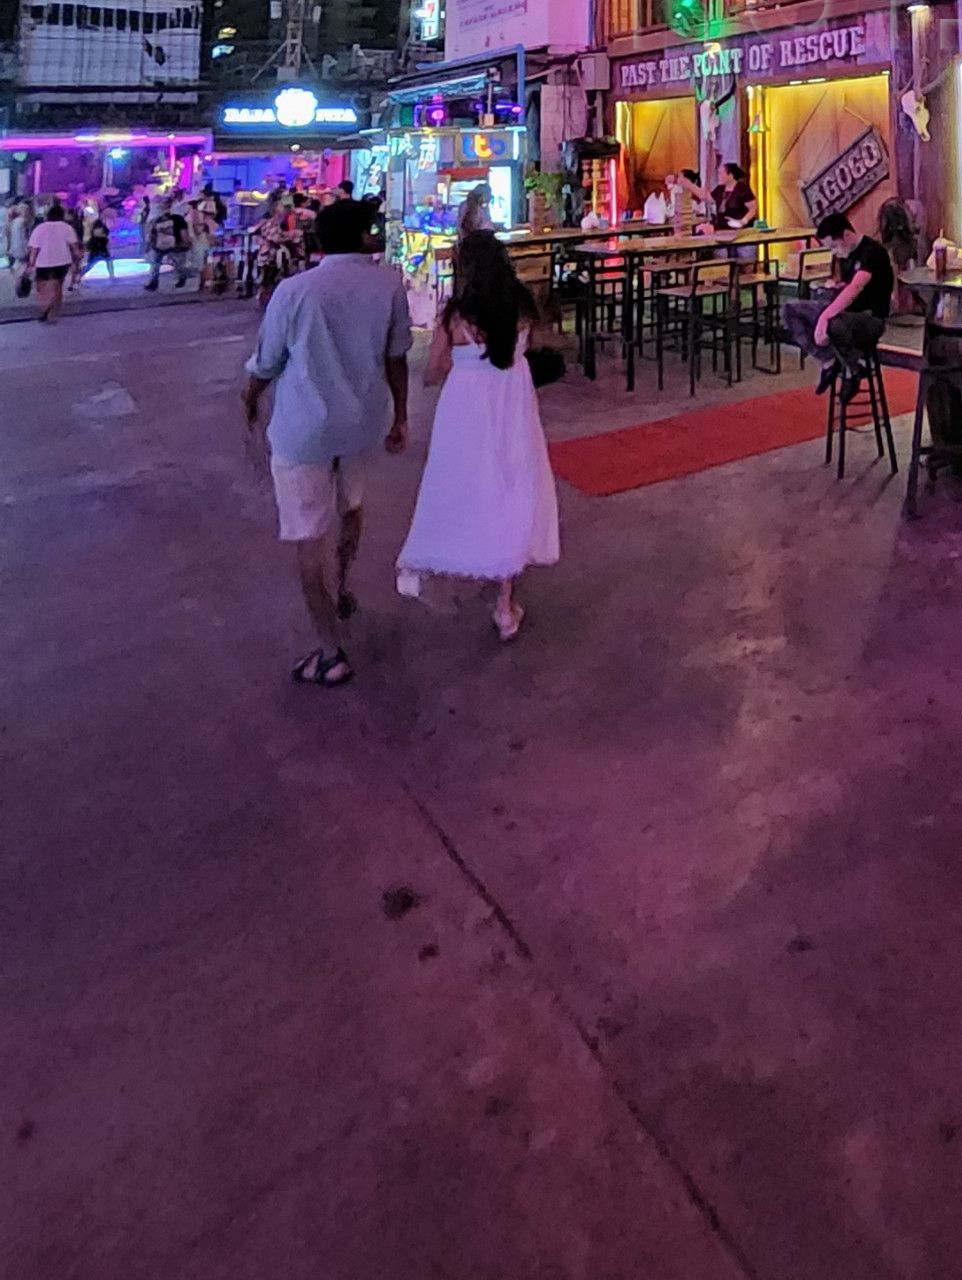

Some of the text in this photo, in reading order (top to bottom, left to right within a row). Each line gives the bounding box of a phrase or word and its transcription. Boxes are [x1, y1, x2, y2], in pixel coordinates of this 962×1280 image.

[621, 26, 865, 87] PAST THE POINT OF RESCUE
[809, 139, 880, 218] AGOGO
